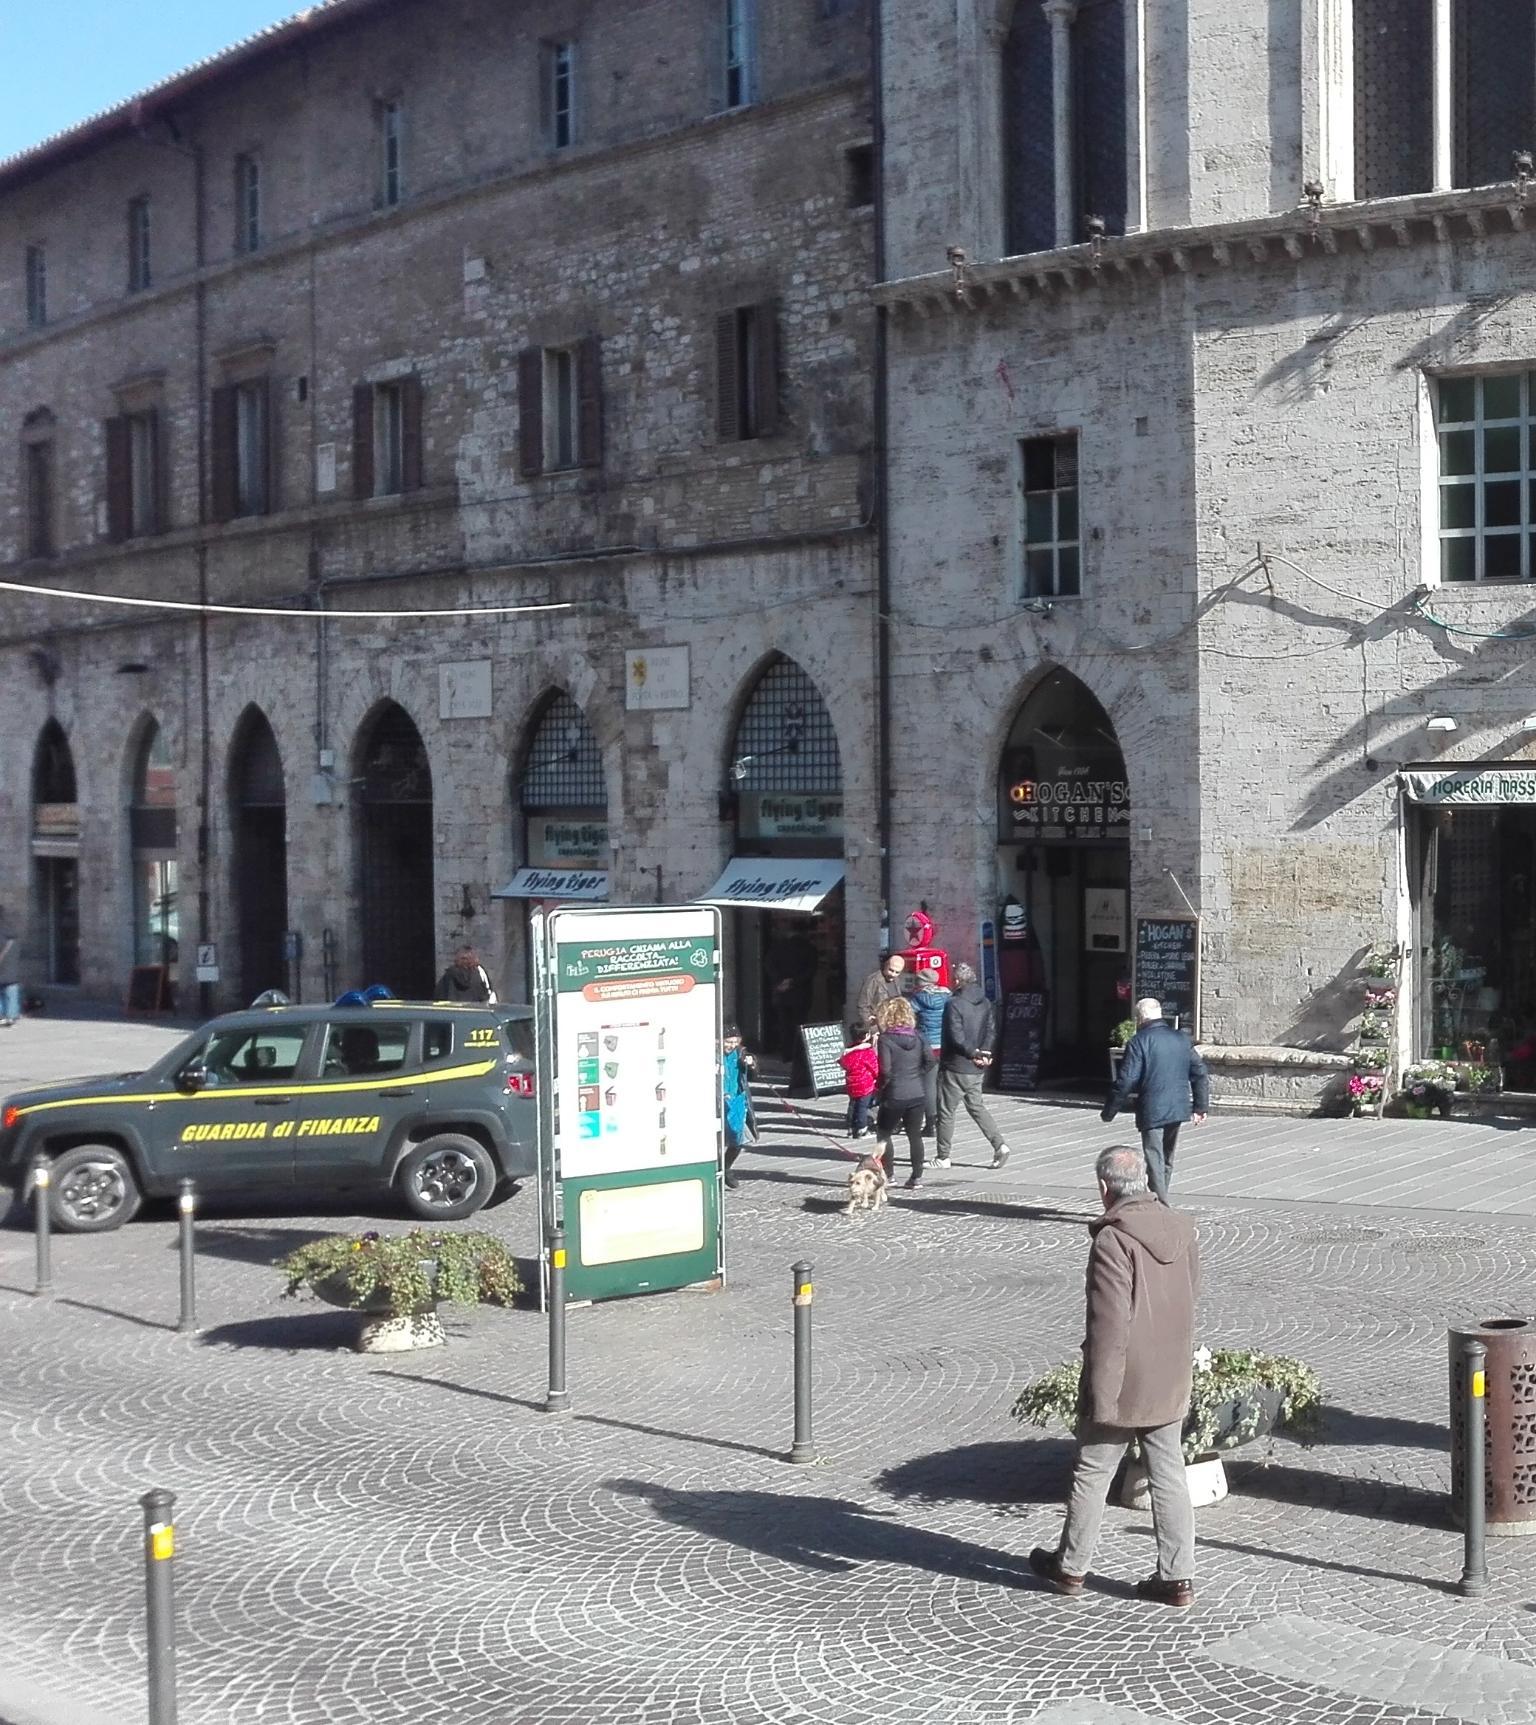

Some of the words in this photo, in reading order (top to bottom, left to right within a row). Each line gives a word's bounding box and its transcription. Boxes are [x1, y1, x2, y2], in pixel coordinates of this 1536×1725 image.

[1019, 781, 1125, 804] HOGAN'S
[1432, 779, 1493, 797] FIORERIA
[761, 798, 802, 822] flying
[1029, 806, 1119, 823] KITCHEN
[544, 825, 580, 846] flying
[522, 872, 564, 891] flying
[565, 872, 606, 891] tiger
[724, 877, 777, 897] flying
[775, 877, 822, 897] tiger
[582, 947, 627, 959] PERUGIA
[668, 940, 692, 950] ALLA
[470, 1029, 493, 1041] 117
[181, 1121, 268, 1142] GUARDIA
[272, 1121, 295, 1138] di
[298, 1115, 380, 1137] FINANZA
